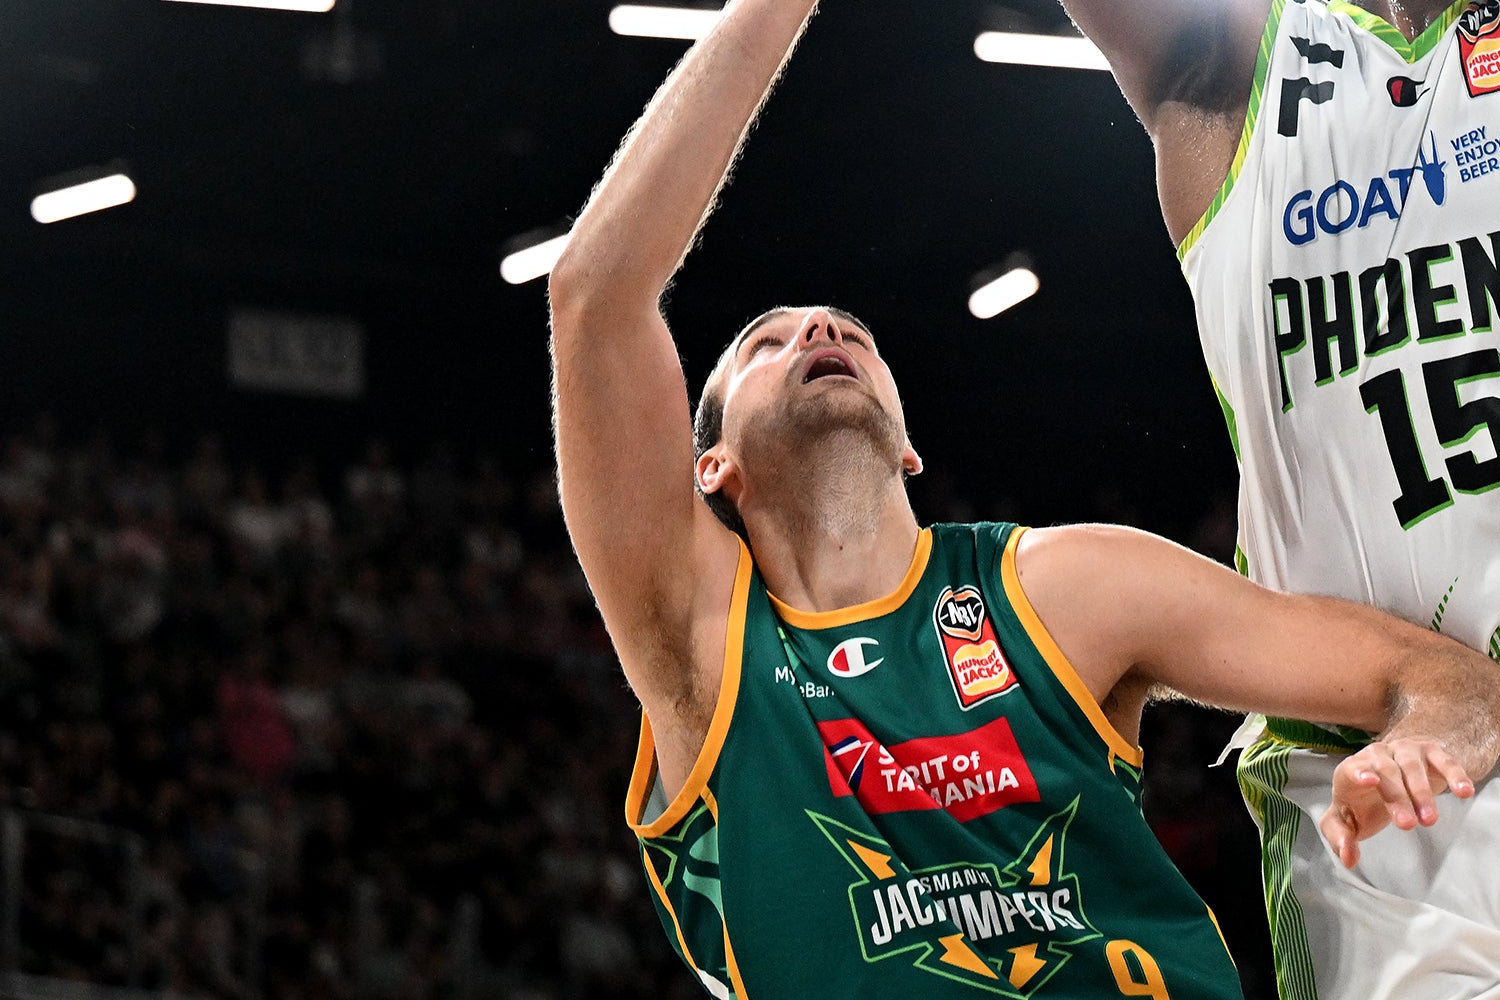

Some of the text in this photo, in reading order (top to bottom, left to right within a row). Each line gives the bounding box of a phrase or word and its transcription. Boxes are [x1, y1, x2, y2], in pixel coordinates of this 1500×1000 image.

[1467, 6, 1493, 31] NL
[1450, 125, 1486, 151] VERY
[1459, 157, 1500, 183] BEER
[1283, 166, 1420, 245] GOAT
[946, 601, 978, 627] NBL
[957, 649, 997, 673] HUNGRY
[952, 750, 981, 773] of
